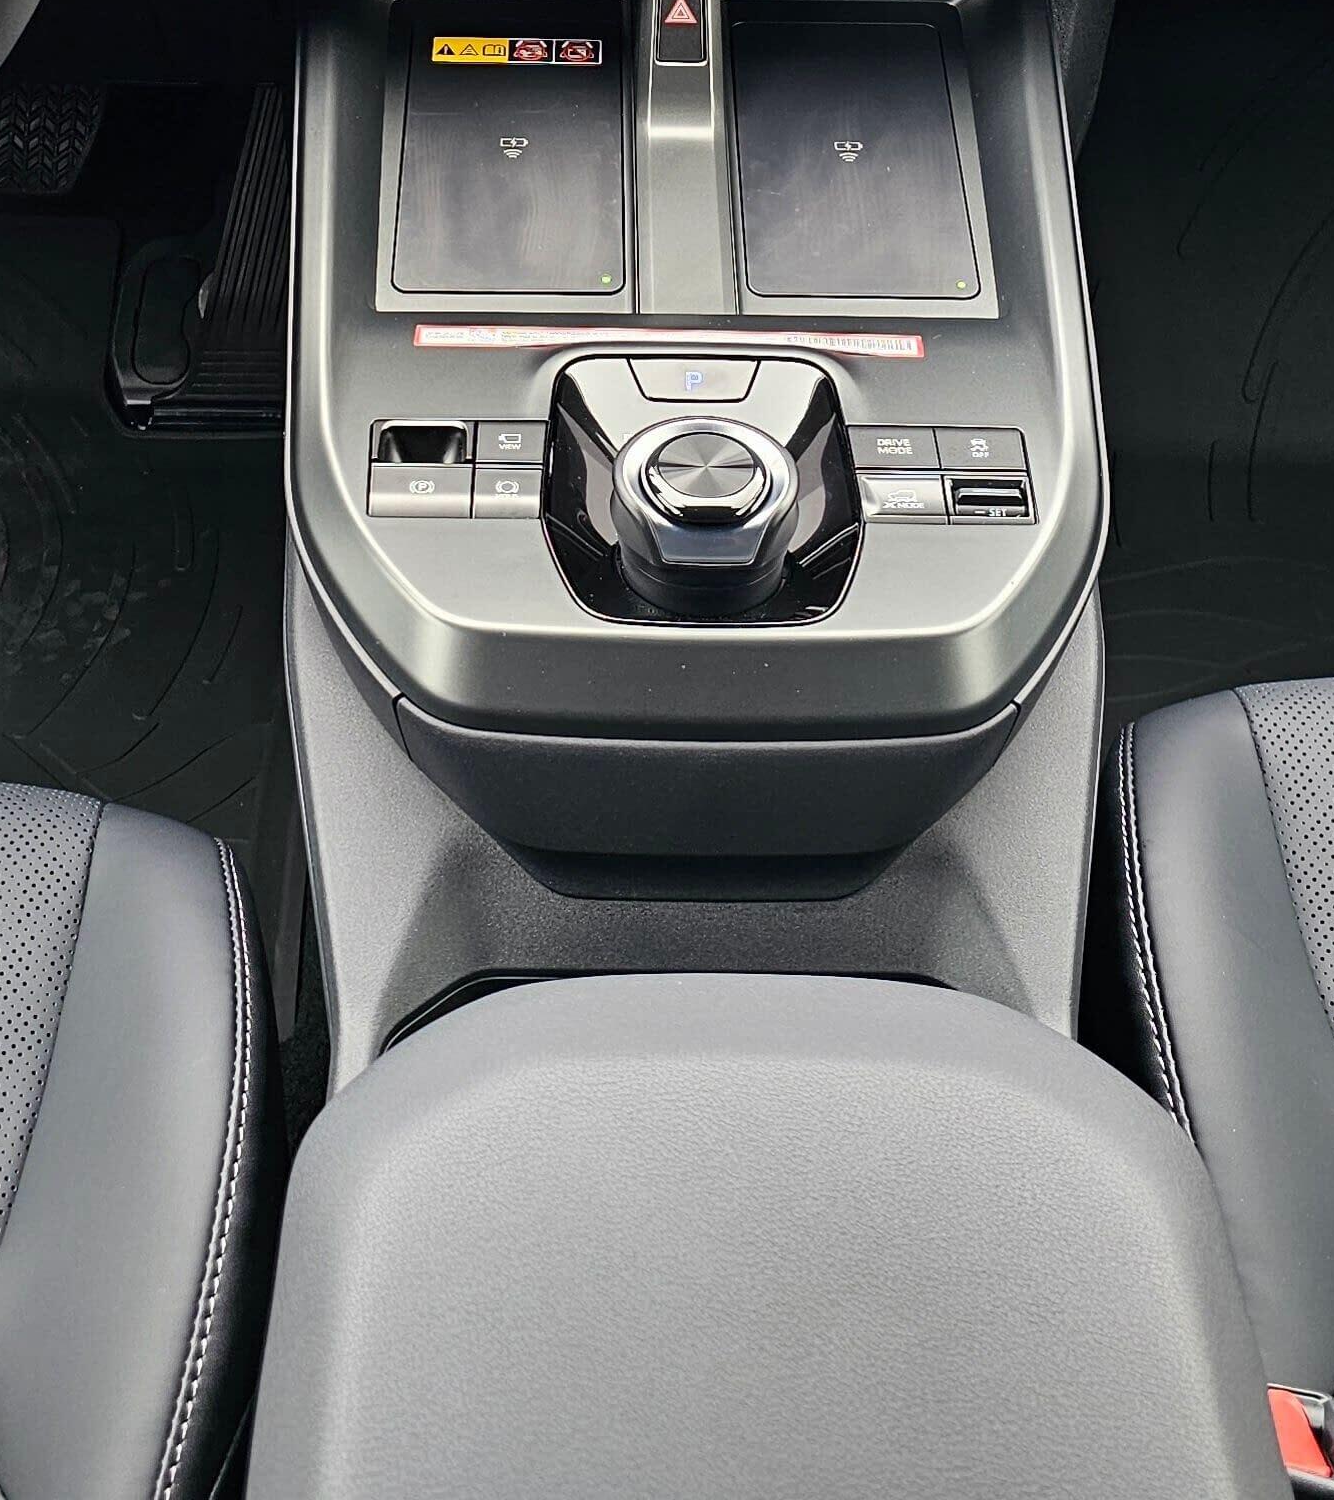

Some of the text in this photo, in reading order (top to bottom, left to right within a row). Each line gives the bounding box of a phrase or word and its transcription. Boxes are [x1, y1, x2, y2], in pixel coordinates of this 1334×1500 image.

[683, 371, 705, 392] P
[877, 438, 910, 447] DRIVE
[877, 447, 913, 455] MODE
[988, 508, 1007, 517] SET
